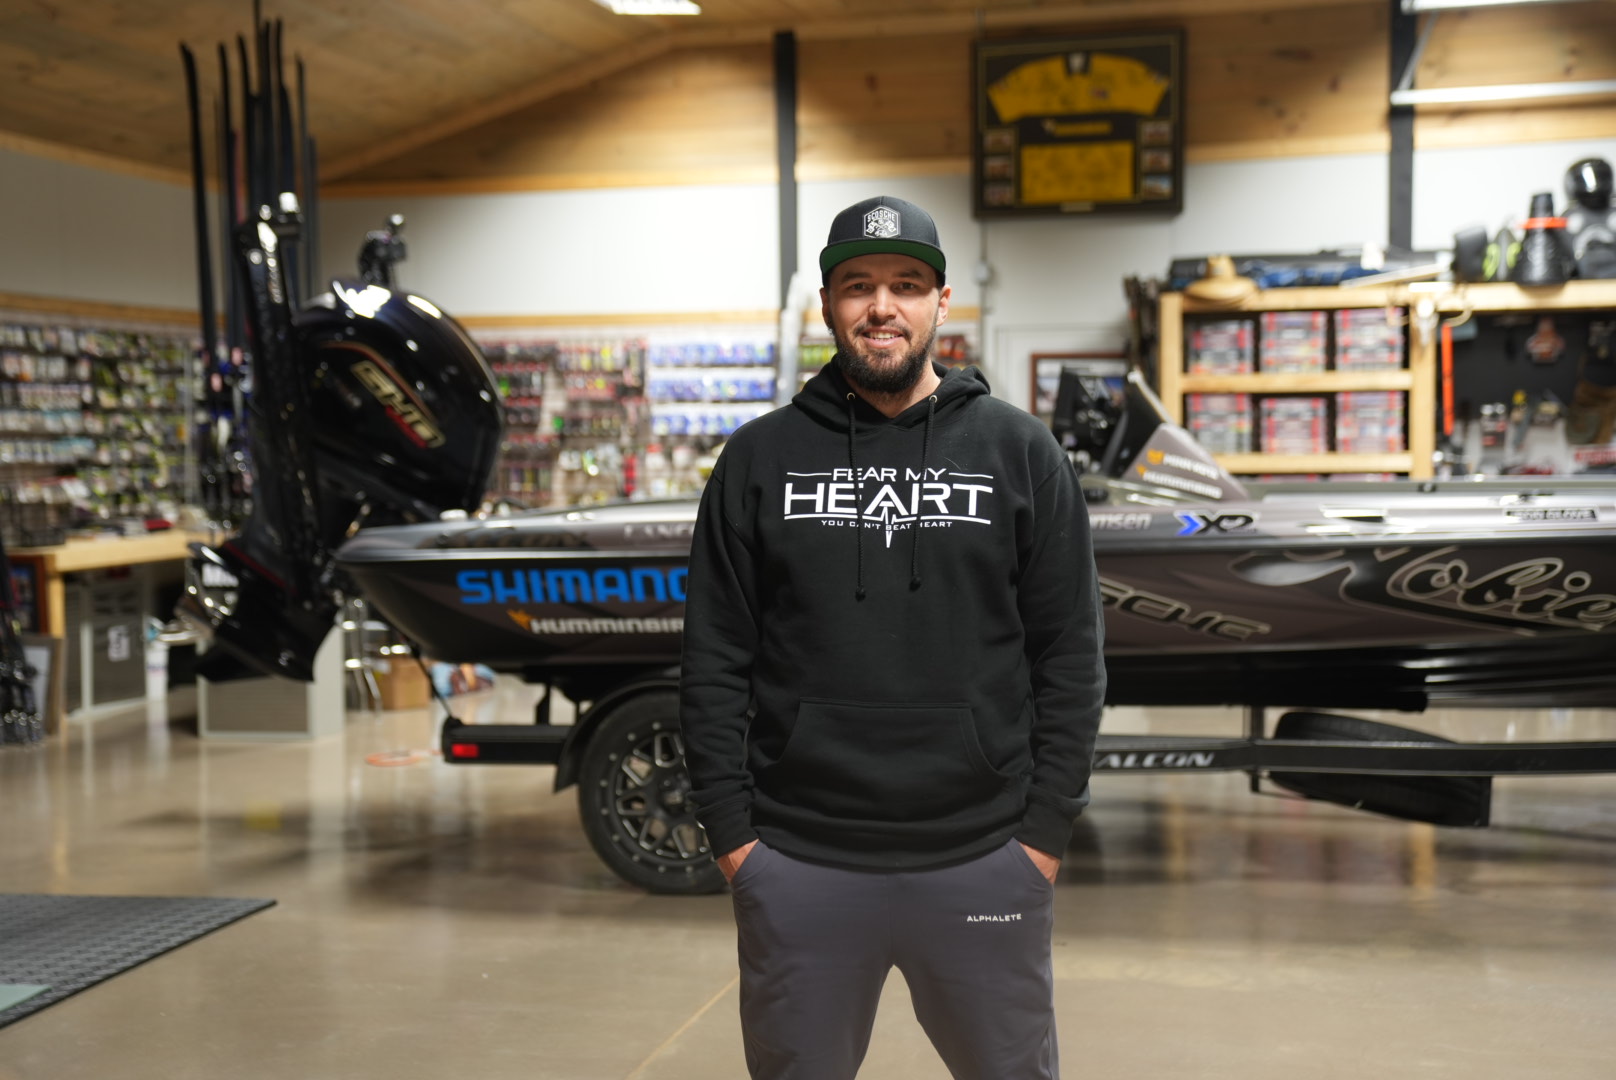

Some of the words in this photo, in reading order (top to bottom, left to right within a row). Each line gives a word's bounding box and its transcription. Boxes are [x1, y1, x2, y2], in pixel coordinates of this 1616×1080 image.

[833, 466, 897, 482] FEAR
[905, 467, 947, 481] MY
[784, 482, 993, 516] HEART
[821, 519, 844, 527] YOU
[849, 520, 881, 530] CN'T
[886, 522, 912, 531] BEAT
[456, 567, 689, 604] SHIMANO
[530, 617, 684, 635] HUMMINBIR
[1094, 752, 1215, 768] ALCON
[966, 913, 1022, 922] ALPHALETE
